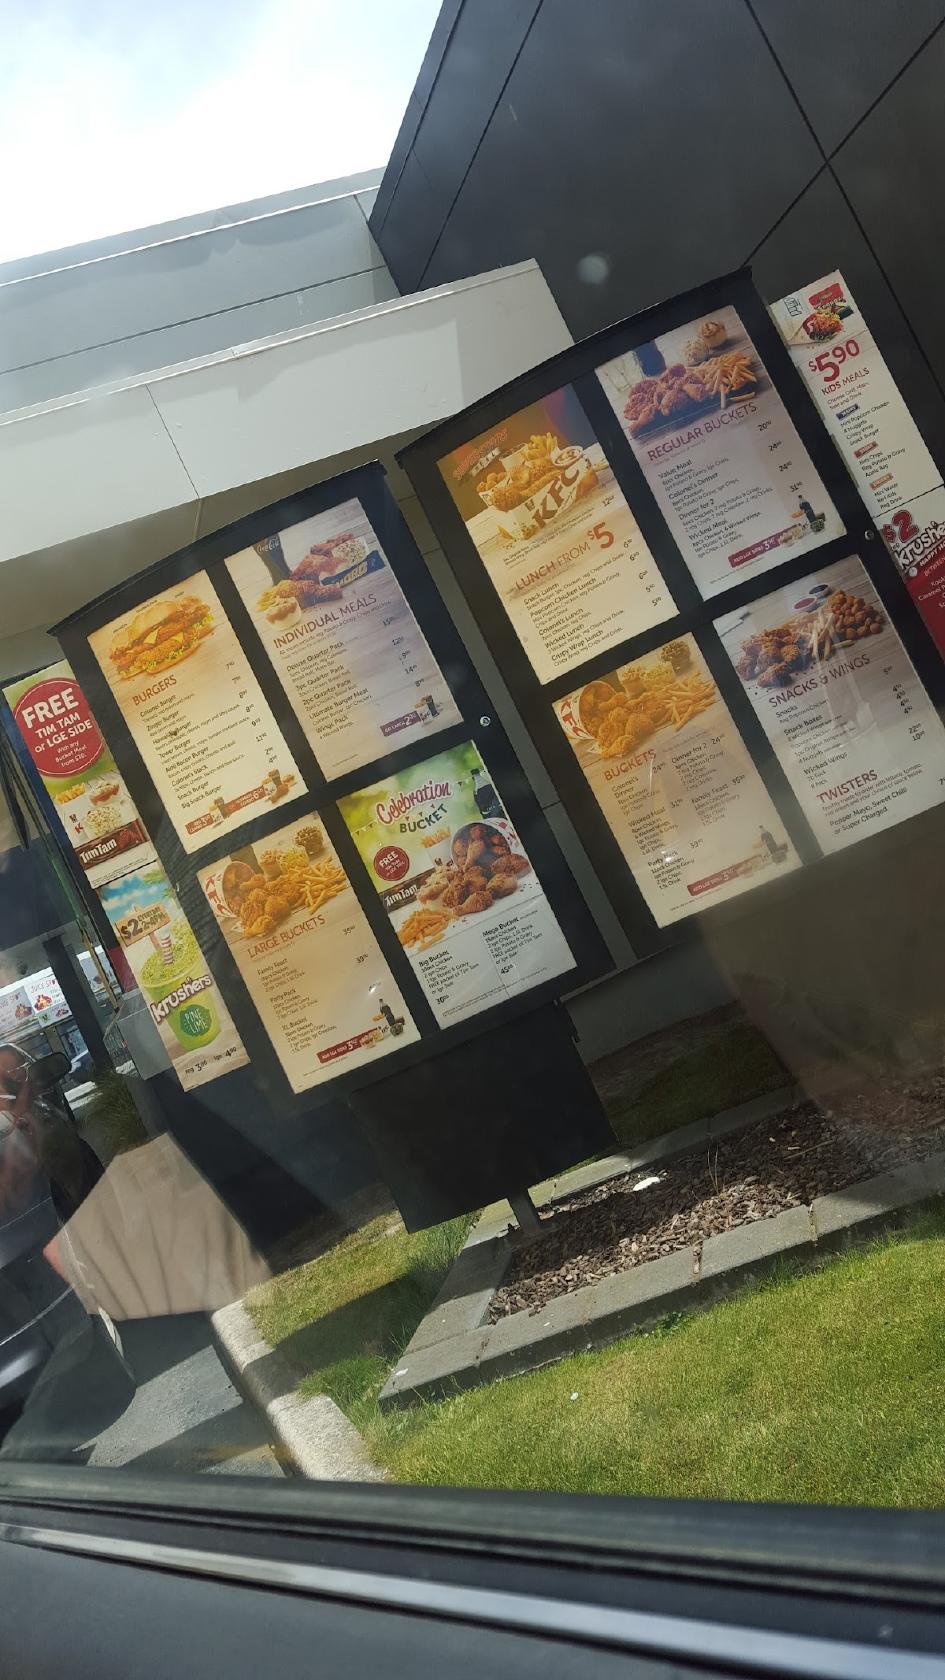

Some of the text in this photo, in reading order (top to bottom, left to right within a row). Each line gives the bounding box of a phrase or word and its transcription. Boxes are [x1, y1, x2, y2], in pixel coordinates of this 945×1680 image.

[820, 366, 870, 396] KIDS MEALS
[646, 426, 704, 461] REGULAR
[702, 400, 758, 434] BUCKETS
[531, 467, 582, 529] KFC
[514, 560, 556, 591] LUNCH
[555, 540, 591, 567] FROM
[586, 520, 614, 549] $5
[523, 591, 541, 605] Snack
[528, 600, 555, 618] Popcorn
[553, 587, 578, 604] Chicken
[577, 576, 597, 591] Lunch
[271, 610, 340, 649] INDIVIDUAL
[338, 591, 378, 617] MEALS
[328, 640, 344, 651] Pack
[544, 632, 567, 649] Wicked
[550, 647, 569, 662] Crispy
[584, 628, 604, 643] Lunch
[329, 664, 345, 675] Pack
[768, 677, 819, 708] SNACKS
[827, 652, 871, 680] WINGS
[131, 673, 178, 706] BURGERS
[336, 678, 352, 689] Pack
[19, 685, 81, 730] FREE
[145, 718, 164, 733] Zinger
[162, 709, 181, 723] Burger
[774, 703, 798, 718] Snacks
[33, 718, 93, 754] or LGE SIDE
[34, 710, 82, 740] TIM TAM
[783, 722, 804, 736] Snack
[173, 737, 192, 751] Burger
[190, 745, 210, 760] Burger
[602, 747, 658, 781] BUCKETS
[803, 759, 828, 775] Wicked
[188, 792, 205, 805] Snack
[203, 783, 223, 798] Burger
[191, 779, 210, 794] Burger
[815, 768, 879, 805] TWISTERS
[374, 779, 452, 826] Celebration
[828, 811, 853, 828] Pepper
[871, 794, 892, 807] Sweet
[399, 803, 448, 834] BUCKET
[840, 818, 861, 832] Super
[859, 805, 889, 824] Charged
[78, 836, 118, 864] TimTam
[378, 849, 399, 868] FREE
[117, 916, 145, 942] $2
[246, 935, 280, 958] LARGE
[279, 913, 326, 943] BUCKETS
[481, 915, 519, 939] Mega Bucket
[418, 948, 450, 968] Big Bucket
[183, 1006, 204, 1024] PINE
[188, 1016, 209, 1035] LIME
